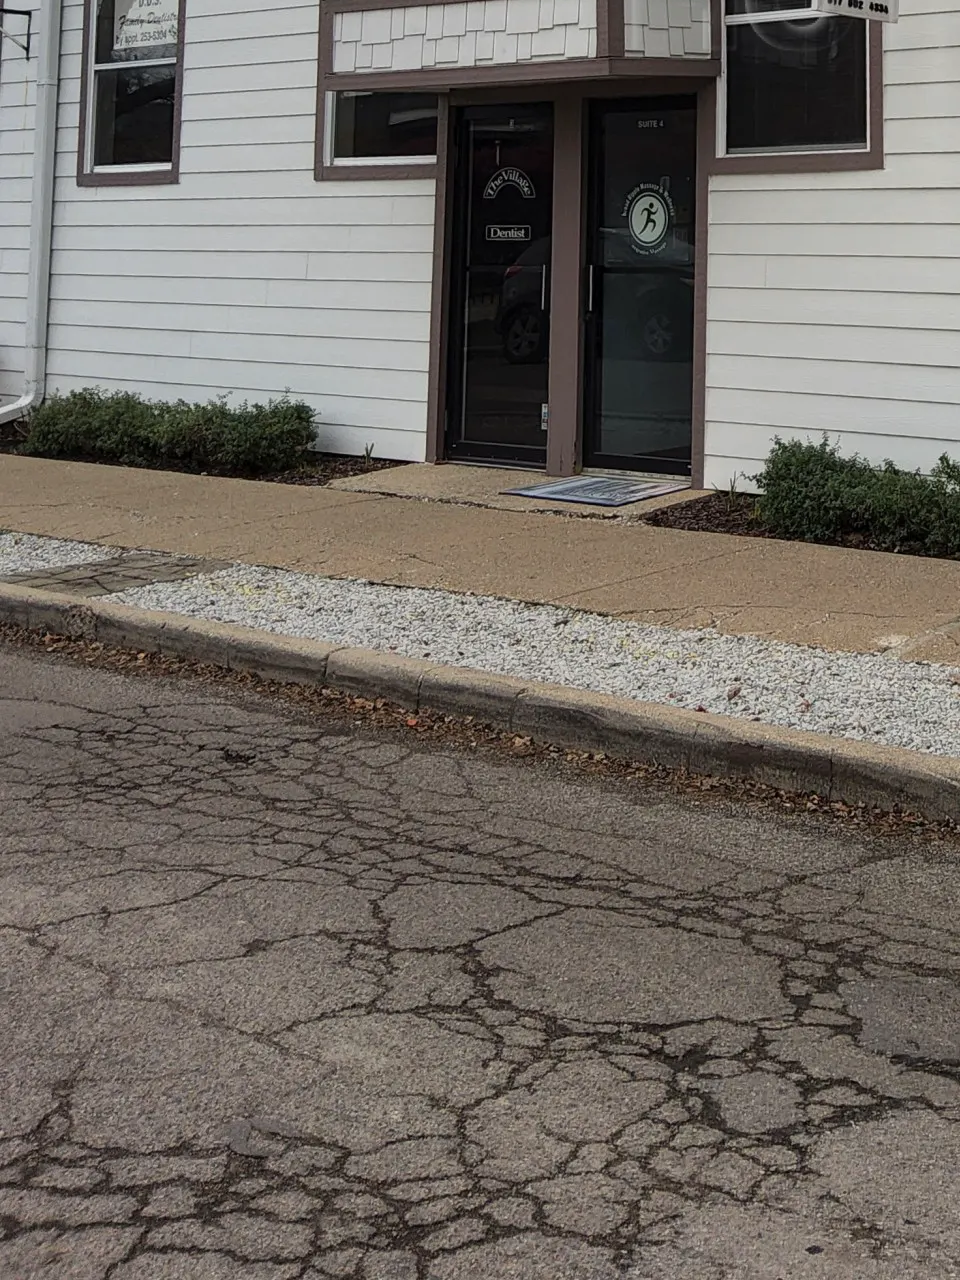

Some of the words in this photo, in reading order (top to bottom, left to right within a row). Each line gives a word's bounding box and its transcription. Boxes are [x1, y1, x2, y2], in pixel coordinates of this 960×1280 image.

[637, 120, 658, 128] SUITE
[486, 175, 504, 196] The
[501, 169, 531, 196] Village
[490, 227, 525, 238] Dentist
